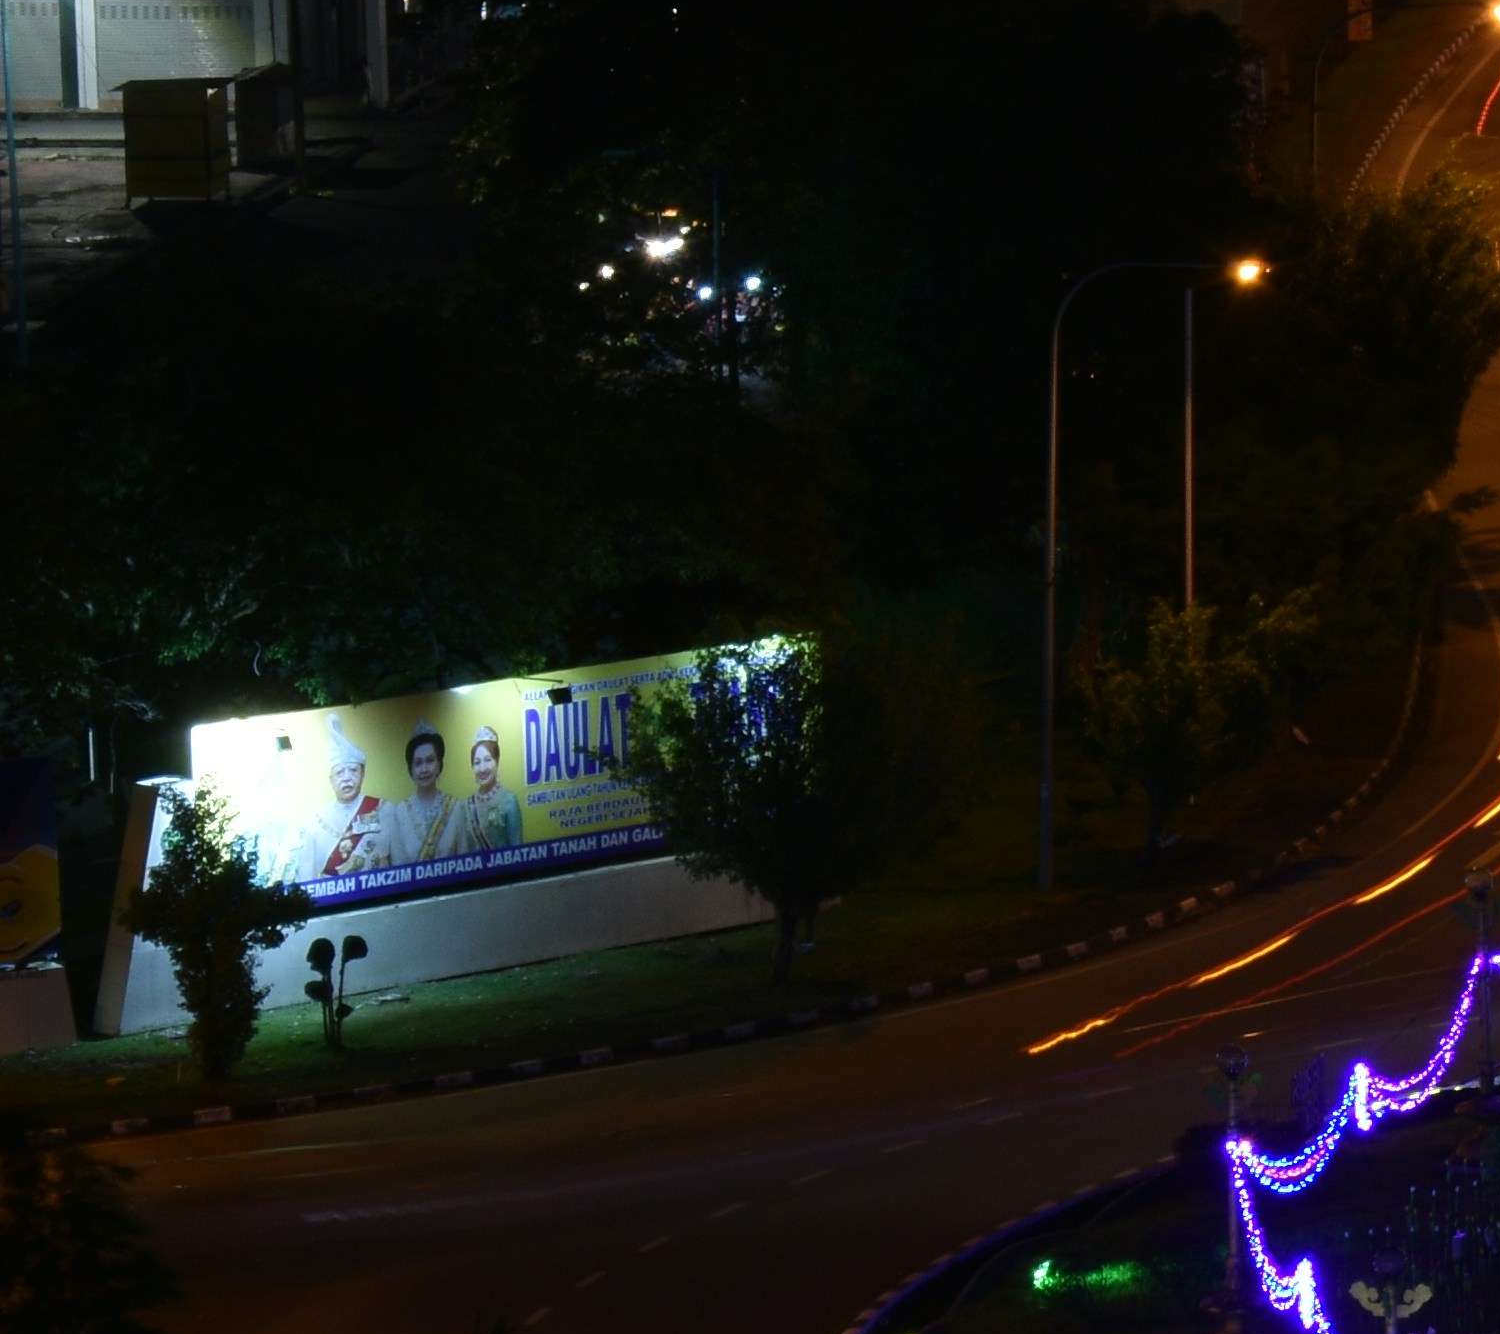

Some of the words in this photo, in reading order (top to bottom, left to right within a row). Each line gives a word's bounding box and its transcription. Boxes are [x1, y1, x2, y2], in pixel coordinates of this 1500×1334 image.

[524, 692, 632, 787] DAULAT
[549, 805, 583, 820] RAJA
[559, 815, 609, 830] NEGERI
[359, 868, 412, 891] TAKZIM
[415, 854, 483, 880] DARIPADA
[486, 844, 548, 868] JABATAN
[552, 834, 598, 857] TANAH
[601, 830, 629, 849] DAN
